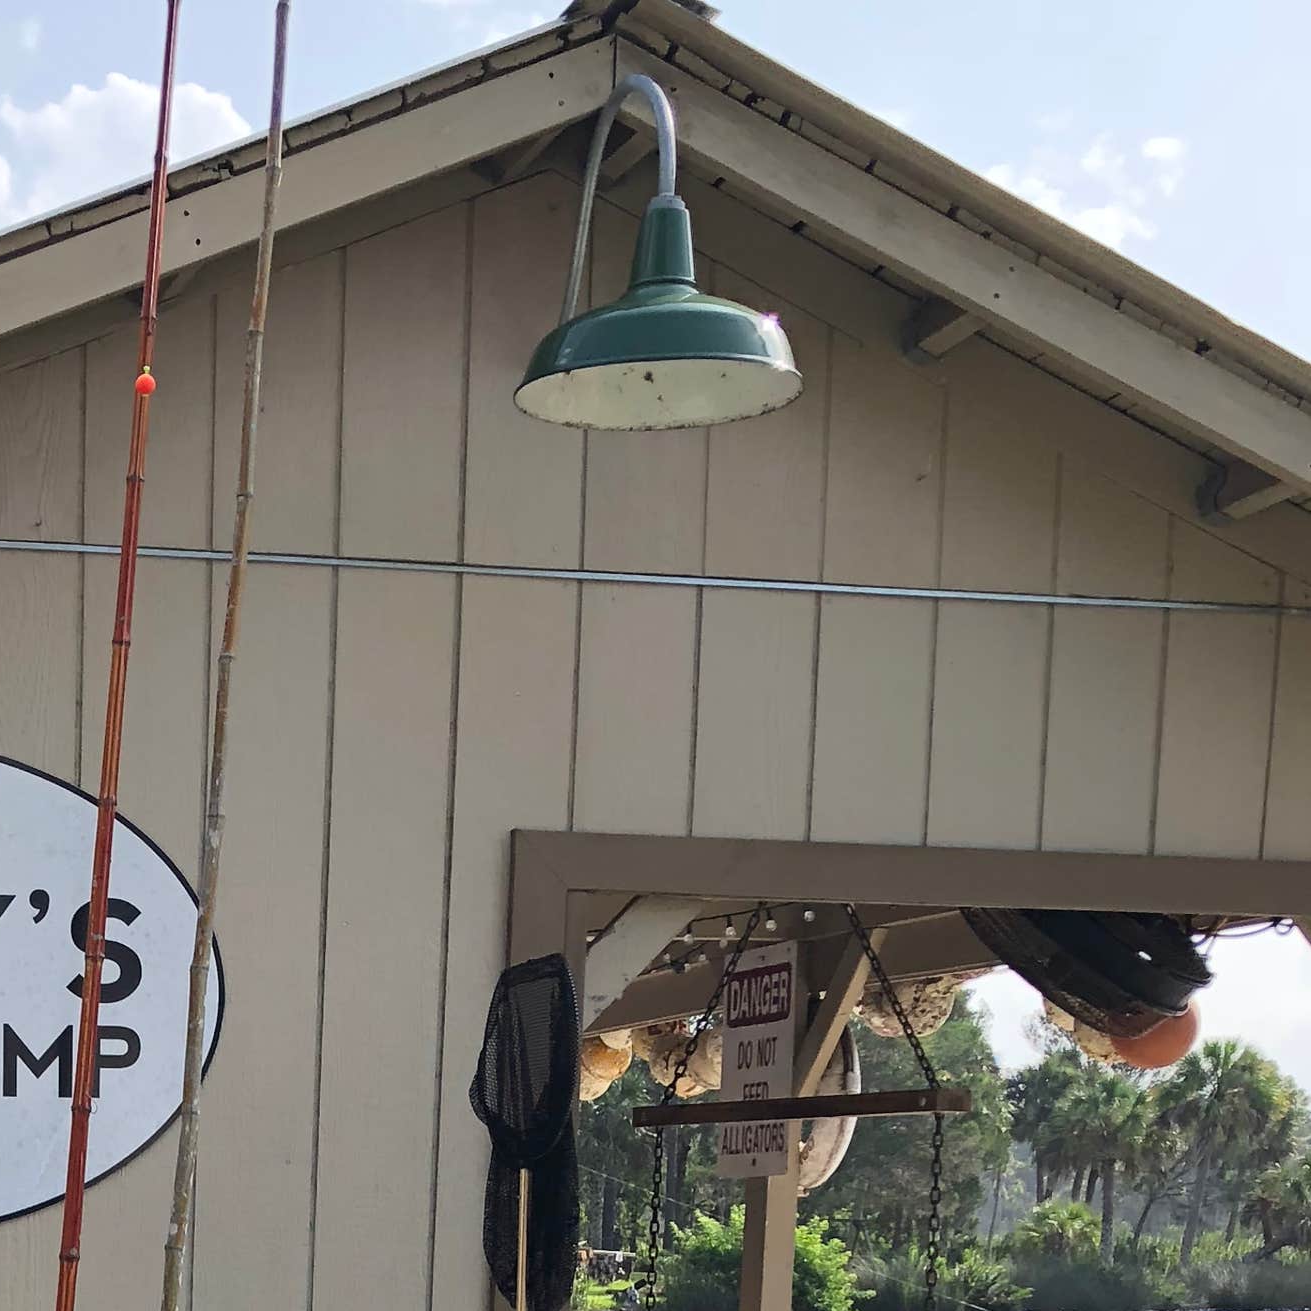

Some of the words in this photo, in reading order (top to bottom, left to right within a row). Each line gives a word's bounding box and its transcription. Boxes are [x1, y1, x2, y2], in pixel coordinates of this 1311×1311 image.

[729, 970, 789, 1020] DANGER
[737, 1040, 753, 1070] DO
[756, 1036, 778, 1068] NOT
[721, 1122, 786, 1156] ALLIGATORS
